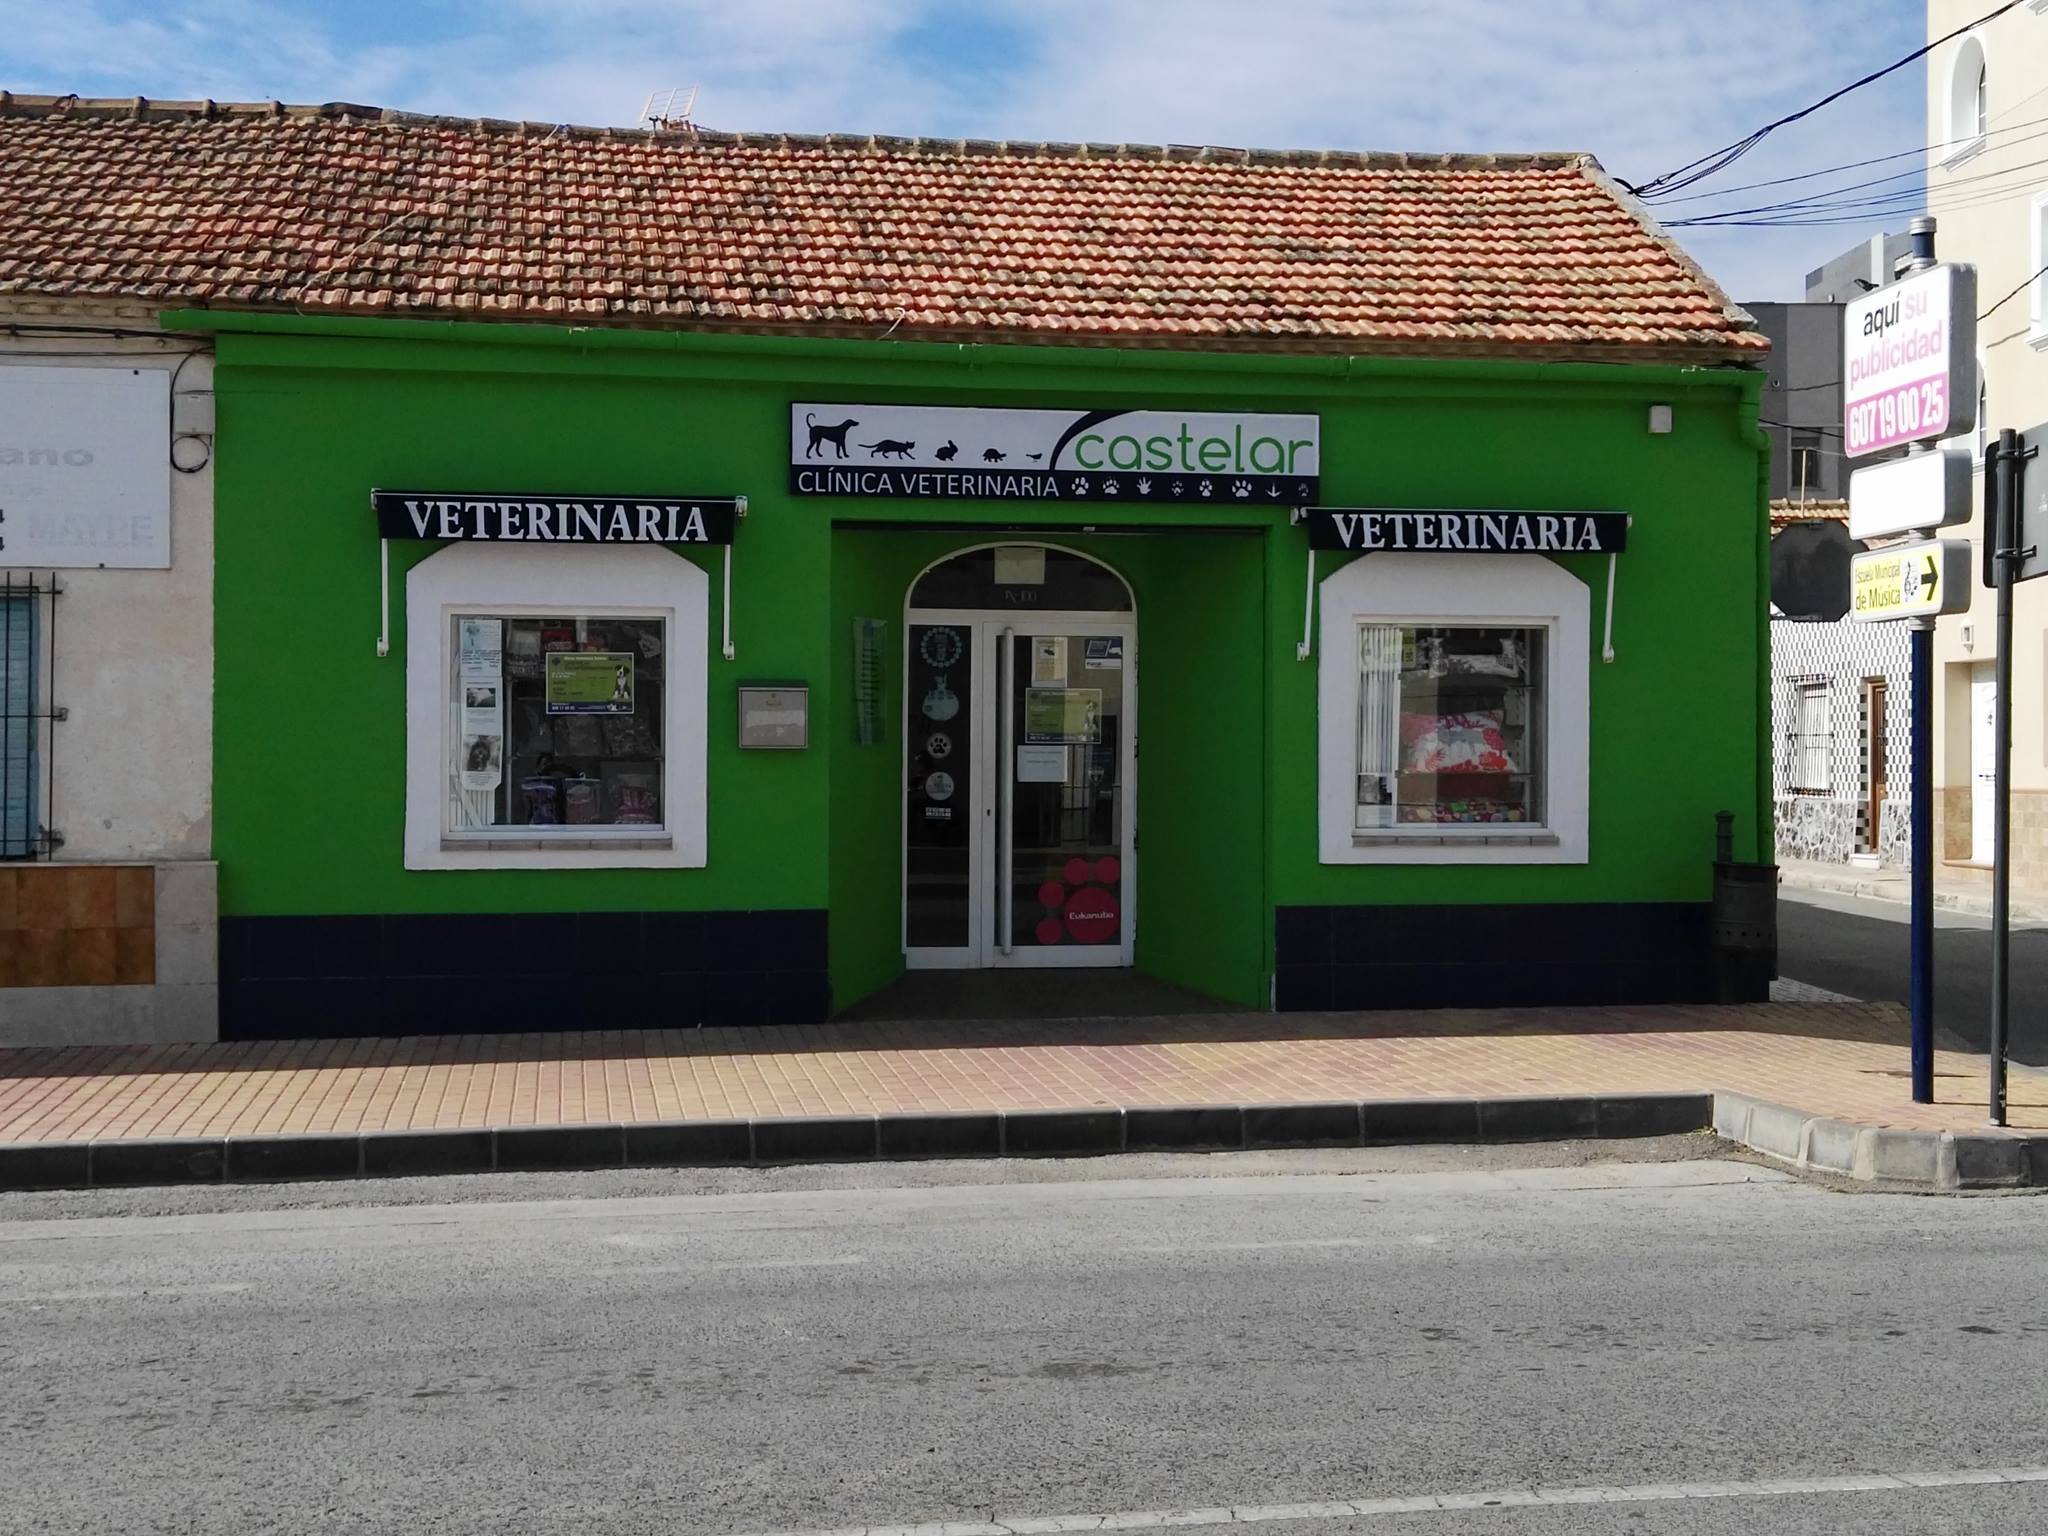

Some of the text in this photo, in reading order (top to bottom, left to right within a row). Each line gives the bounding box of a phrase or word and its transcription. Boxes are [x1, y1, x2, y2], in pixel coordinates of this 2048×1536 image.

[1864, 290, 1928, 338] aquí su
[1850, 319, 1943, 391] publicidad
[1850, 380, 1943, 449] 607 19 00 25
[1075, 422, 1313, 474] castelar
[798, 467, 1060, 497] CLÍNICA VETERINARIA
[404, 501, 709, 541] VETERINARIA
[1331, 513, 1602, 550] VETERINARIA
[1855, 584, 1901, 611] de Música
